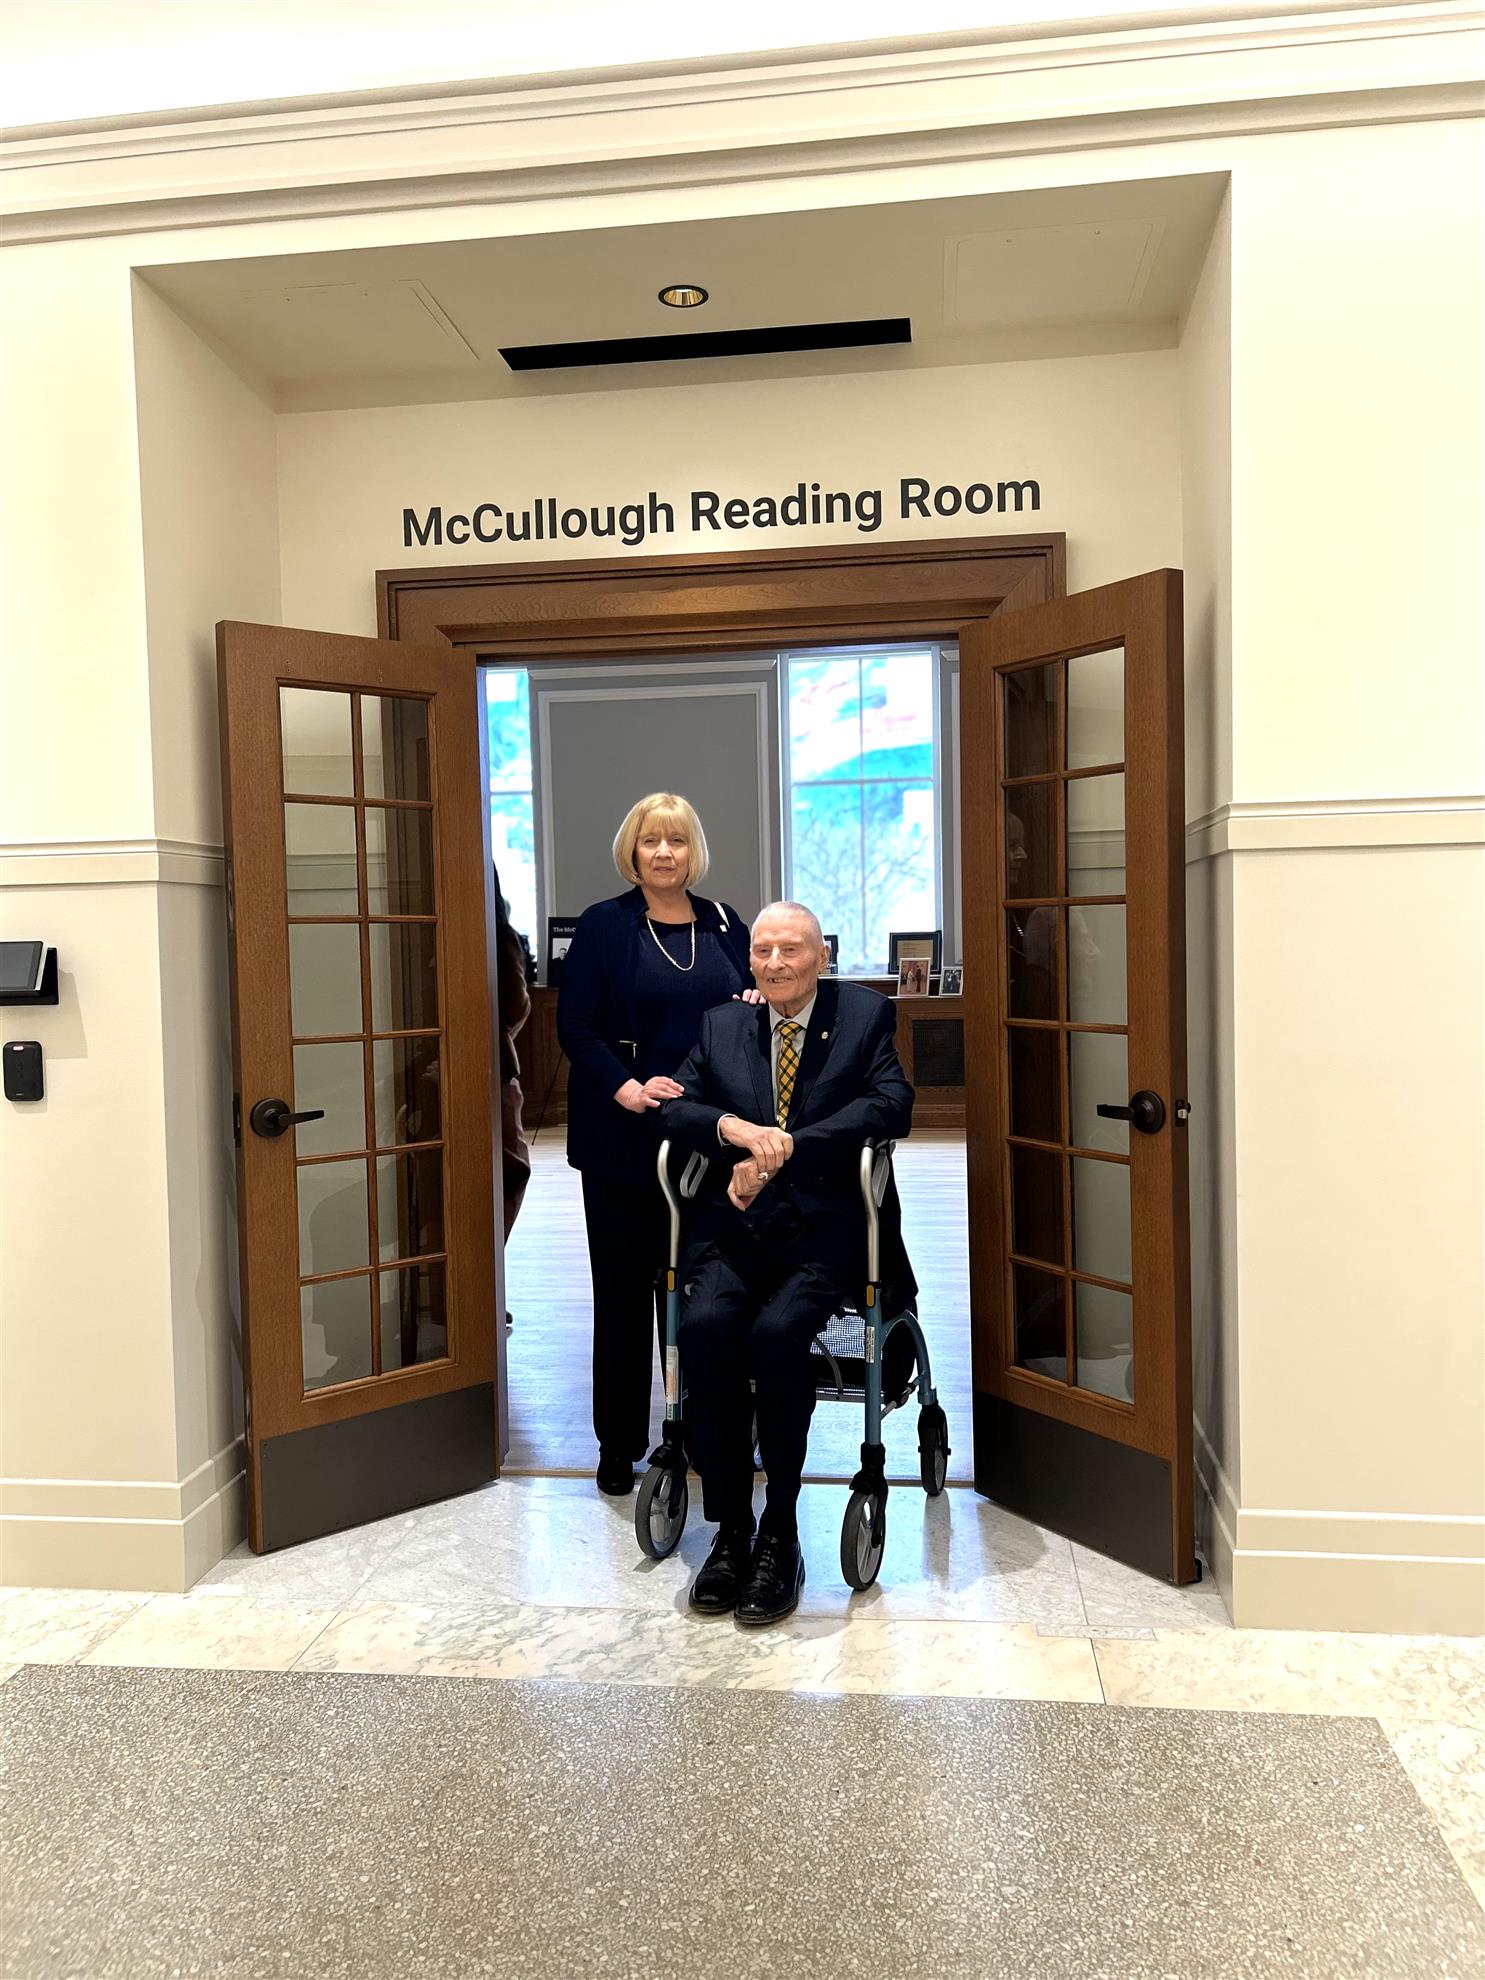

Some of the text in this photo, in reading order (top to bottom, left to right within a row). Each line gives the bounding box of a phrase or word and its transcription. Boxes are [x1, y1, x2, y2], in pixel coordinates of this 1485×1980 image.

[402, 477, 1042, 547] McCullough Reading Room
